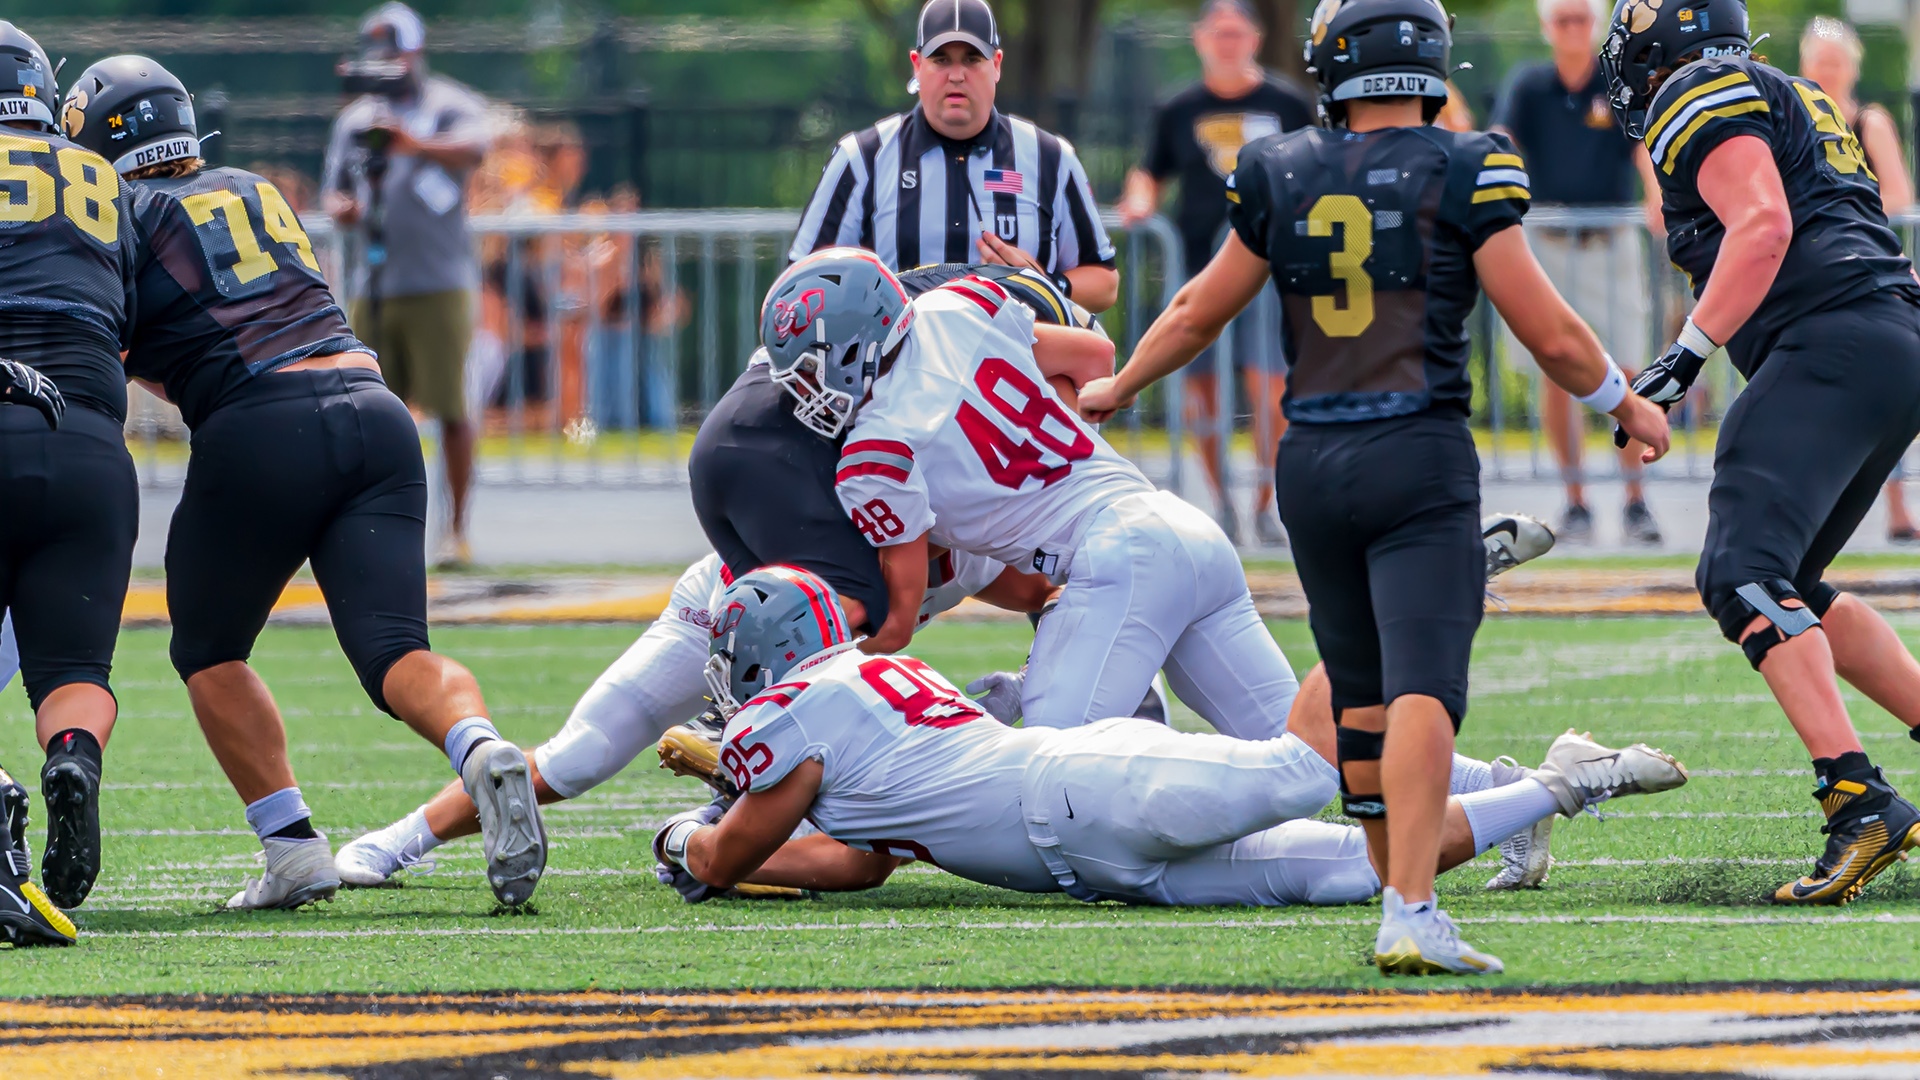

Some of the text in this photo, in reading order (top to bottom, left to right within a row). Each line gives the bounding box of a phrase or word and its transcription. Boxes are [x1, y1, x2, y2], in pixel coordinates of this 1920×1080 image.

[1679, 10, 1693, 22] 50
[1363, 77, 1428, 93] DEPAUW
[108, 115, 123, 128] 74
[1793, 82, 1878, 182] 5
[136, 141, 189, 166] DEPAUW
[0, 134, 120, 244] 58
[902, 170, 918, 189] S
[180, 183, 322, 285] 74
[997, 216, 1016, 241] U
[1308, 195, 1375, 338] 3
[954, 358, 1095, 491] 48
[851, 498, 905, 544] 48
[721, 725, 774, 791] 85
